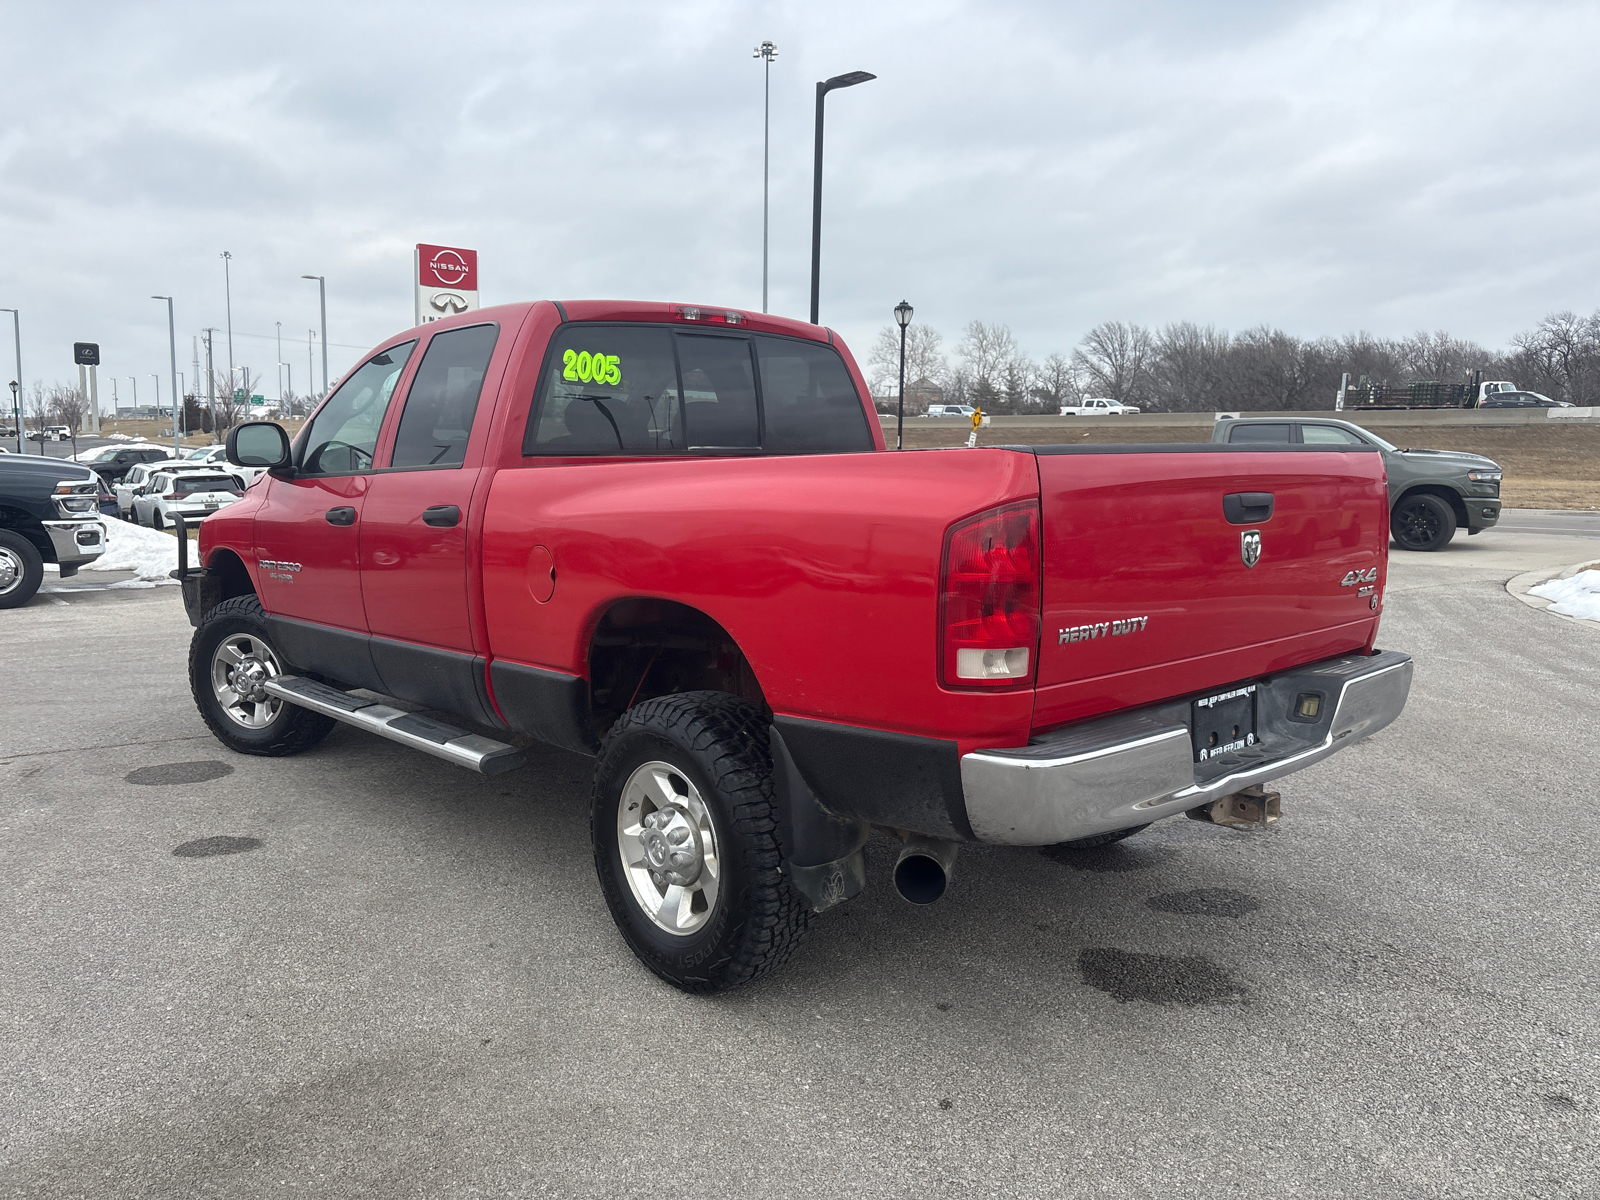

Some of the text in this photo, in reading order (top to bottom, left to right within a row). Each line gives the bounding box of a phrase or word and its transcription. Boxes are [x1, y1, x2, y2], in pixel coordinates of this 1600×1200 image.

[430, 261, 468, 272] NISSAN
[563, 349, 621, 385] 2005
[1058, 616, 1148, 645] HEAVY DUTY
